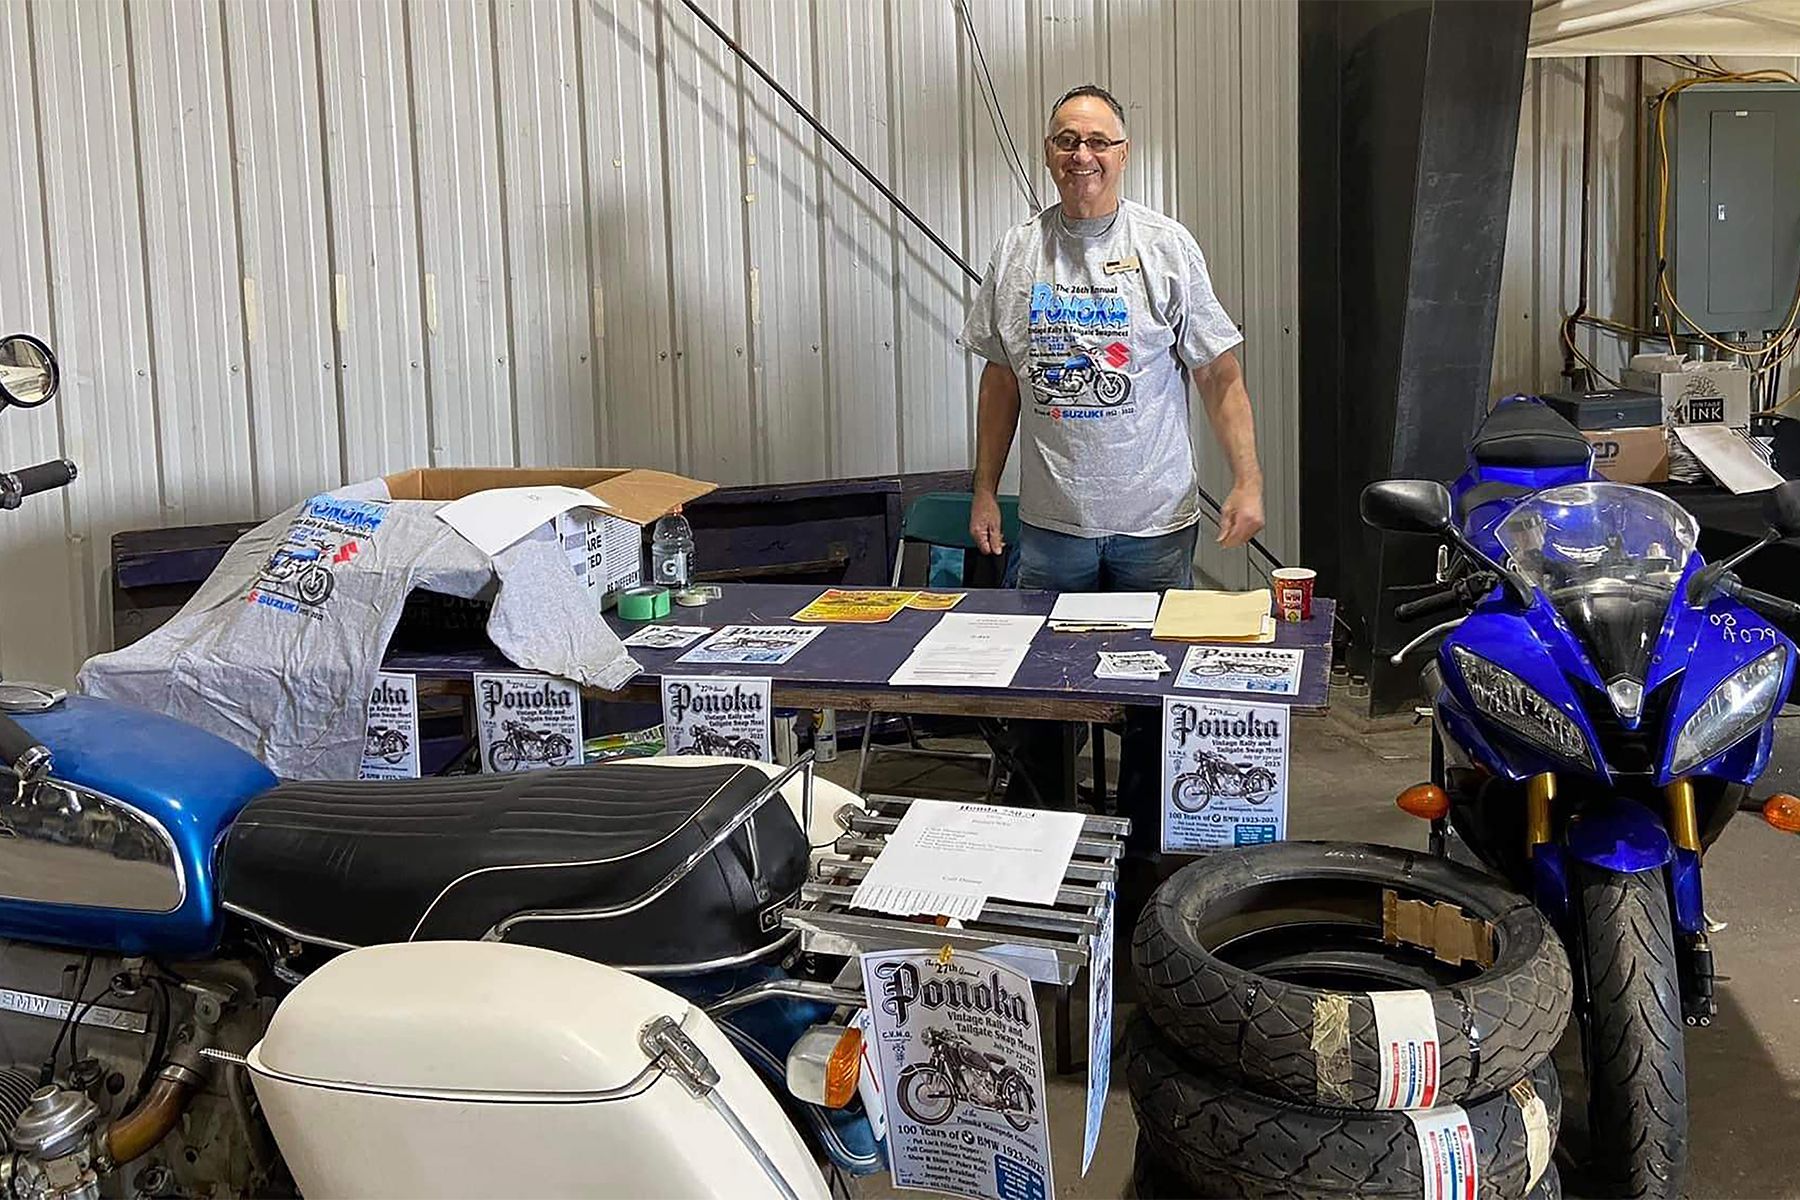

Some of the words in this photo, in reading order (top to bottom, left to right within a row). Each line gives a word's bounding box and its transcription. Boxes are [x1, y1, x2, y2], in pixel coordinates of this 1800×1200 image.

[1056, 284, 1069, 293] The
[1070, 285, 1089, 294] 26th
[1091, 285, 1118, 294] Annual
[1062, 409, 1103, 418] SUZUKI
[1692, 407, 1721, 420] INK
[662, 560, 677, 576] G
[258, 595, 299, 613] SUZUKI
[1195, 648, 1293, 659] Ponoka
[371, 679, 409, 705] oka
[481, 680, 573, 719] Ponoka
[667, 683, 763, 724] Ponoka
[1170, 703, 1281, 748] Ponoka
[1169, 812, 1183, 820] 100
[935, 963, 958, 975] 27th
[875, 961, 1032, 1028] Ponoka
[947, 1012, 983, 1026] Vintage
[985, 1017, 1006, 1033] Rally
[1008, 1026, 1023, 1038] and
[955, 1022, 993, 1038] Tailgate
[994, 1030, 1016, 1047] Swap
[1018, 1061, 1036, 1078] 2023
[898, 1125, 917, 1134] 100
[920, 1126, 947, 1138] Years
[949, 1131, 959, 1140] of
[977, 1135, 1000, 1151] BMW
[1003, 1145, 1045, 1175] 1923-2023
